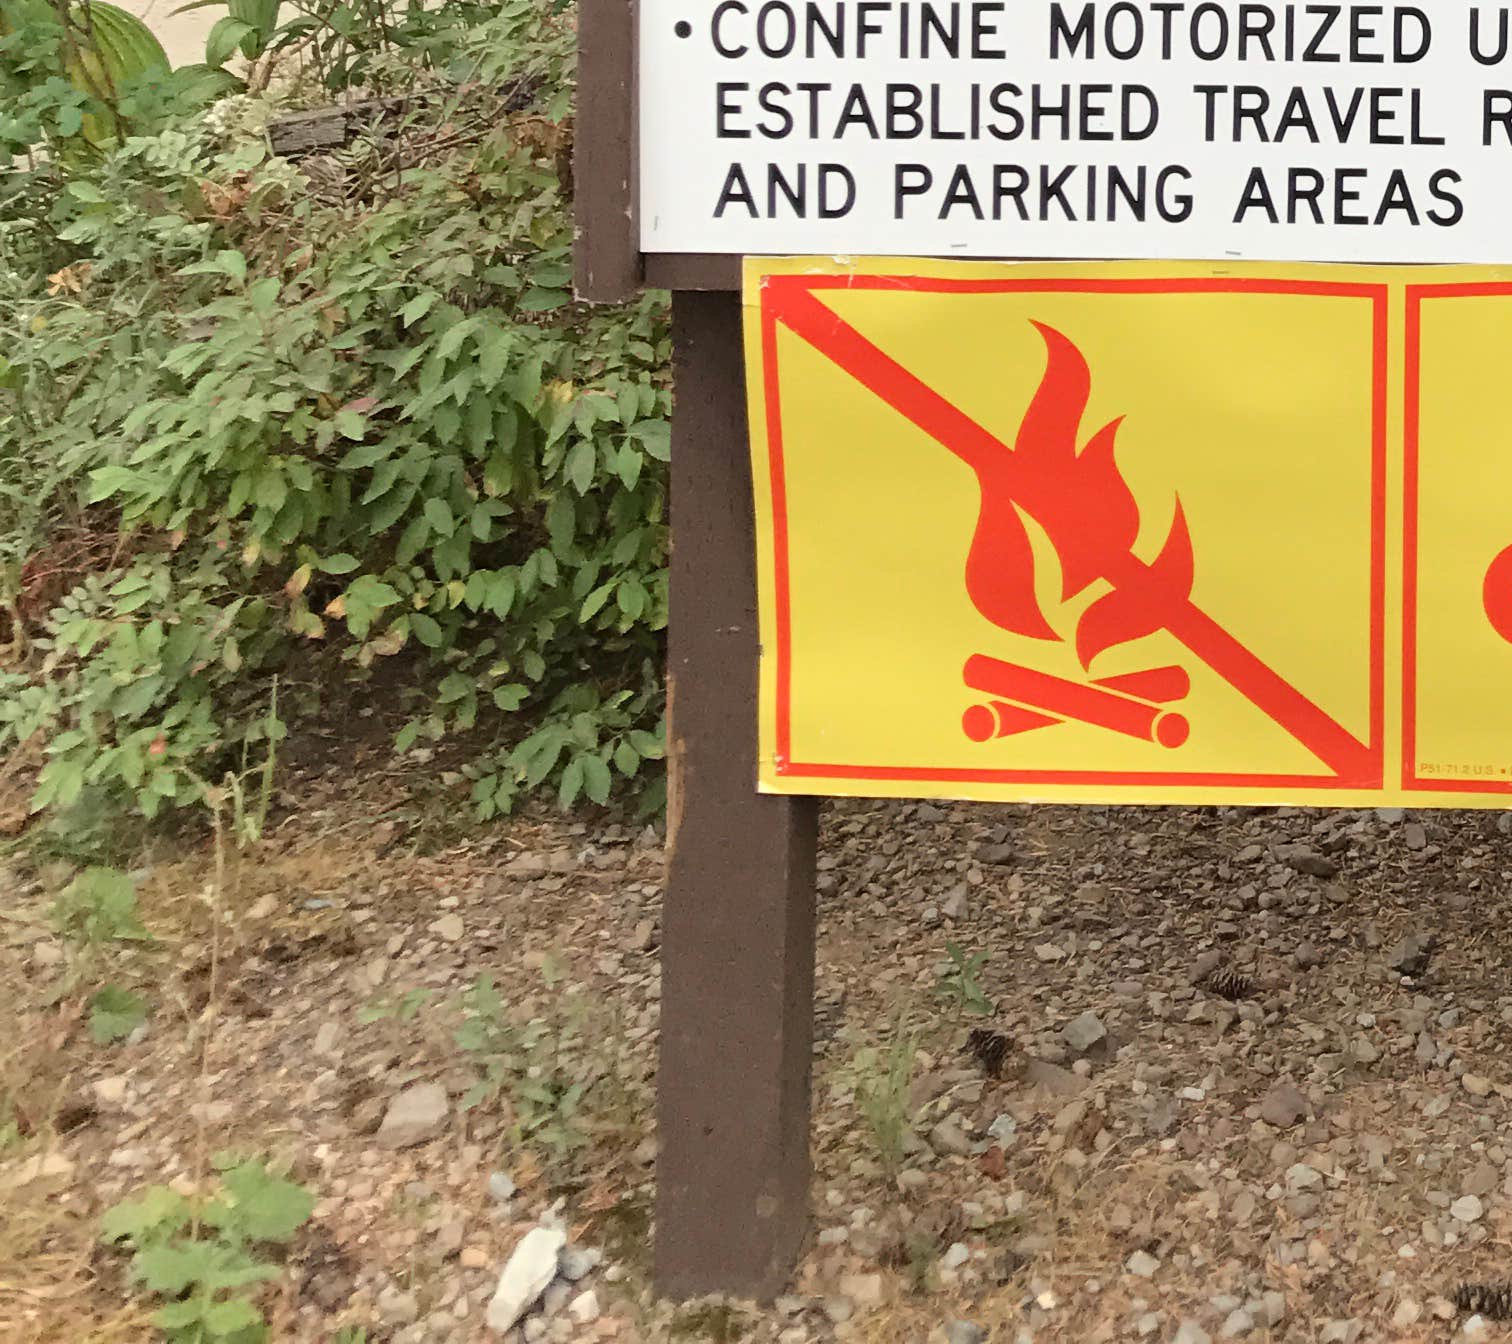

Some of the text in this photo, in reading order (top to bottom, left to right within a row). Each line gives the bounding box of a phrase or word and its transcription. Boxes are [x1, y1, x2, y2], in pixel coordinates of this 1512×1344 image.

[712, 0, 1006, 59] CONFINE
[1050, 2, 1431, 63] MOTORIZED
[717, 82, 1158, 140] ESTABLISHED
[1194, 85, 1445, 145] TRAVEL
[713, 163, 1463, 226] AND PARKING AREAS
